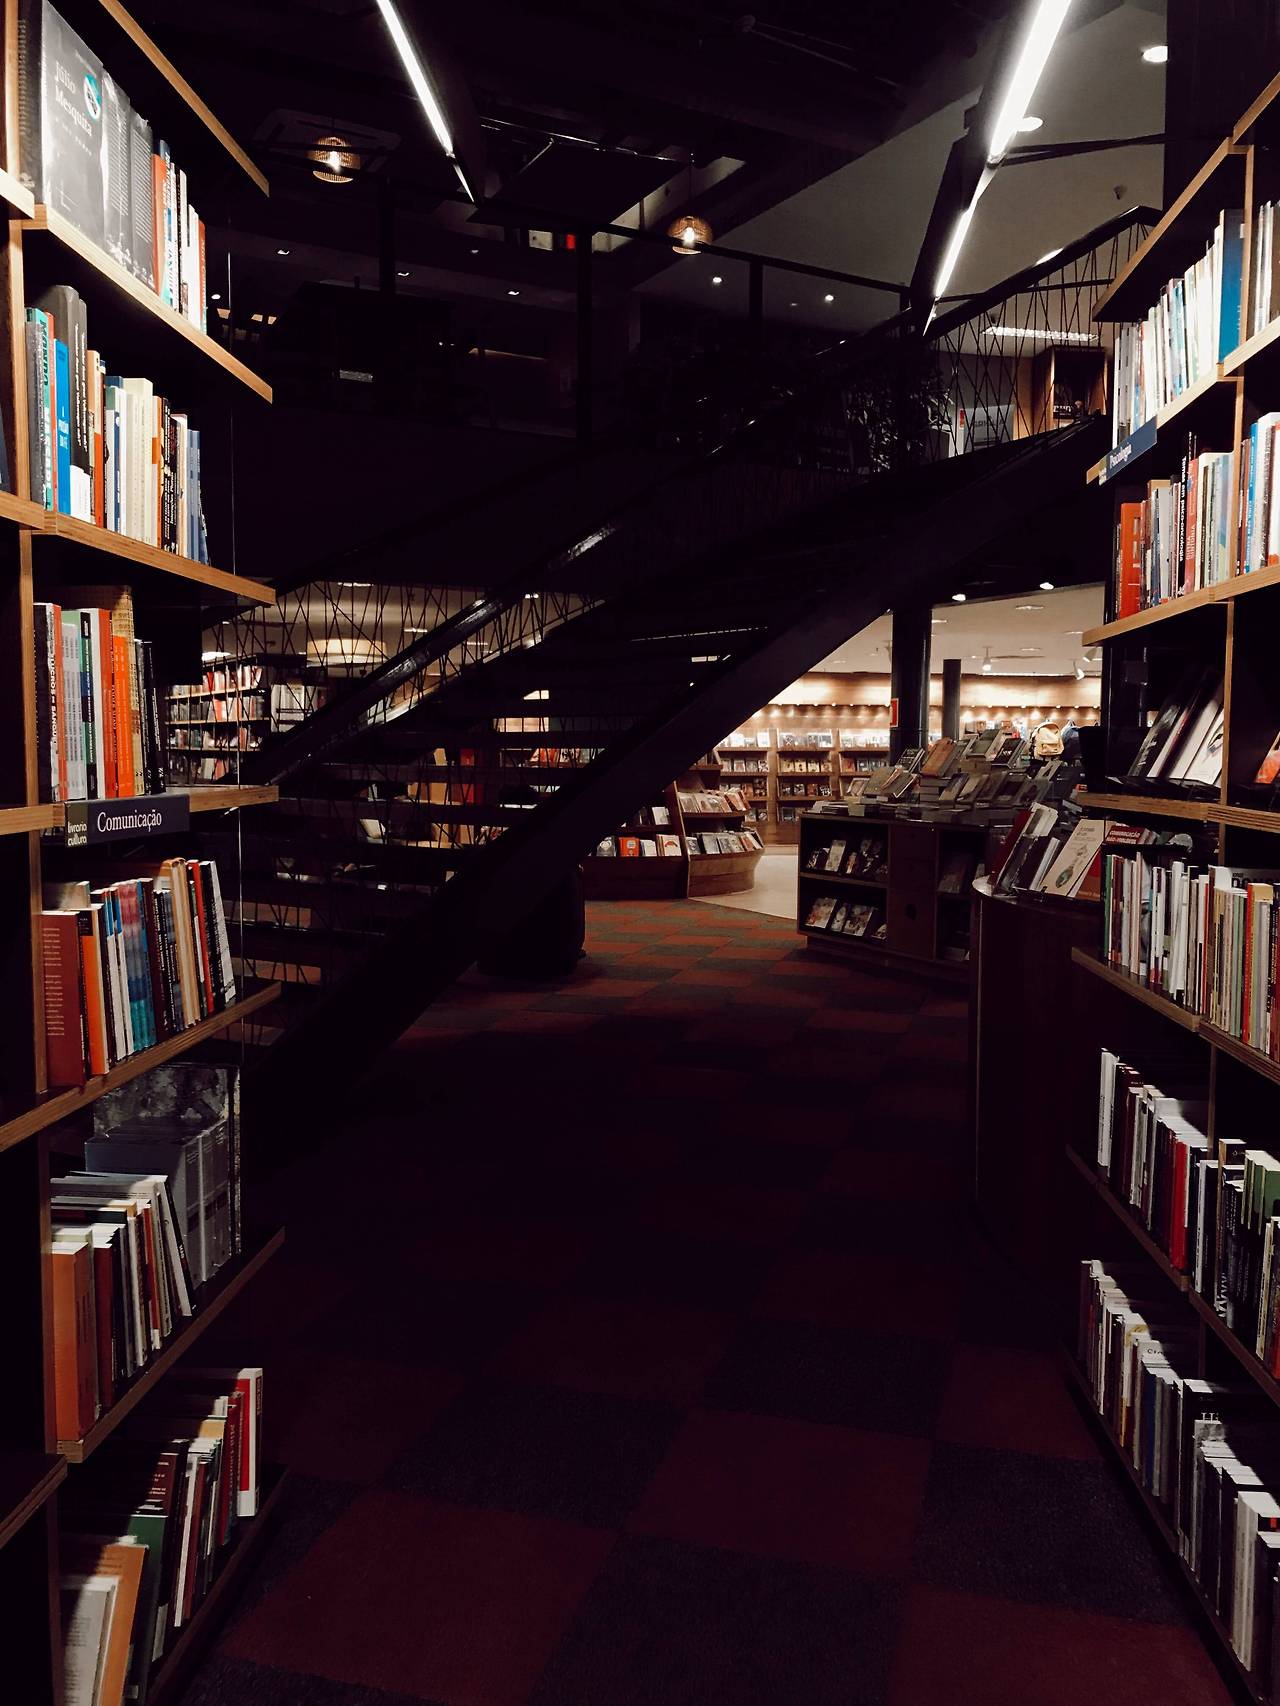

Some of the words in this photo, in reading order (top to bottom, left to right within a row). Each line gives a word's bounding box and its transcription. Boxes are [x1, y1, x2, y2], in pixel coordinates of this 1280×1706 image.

[55, 85, 92, 137] Mesquita
[67, 821, 88, 834] livraria
[97, 809, 162, 833] Comunicação
[67, 833, 88, 847] cultura
